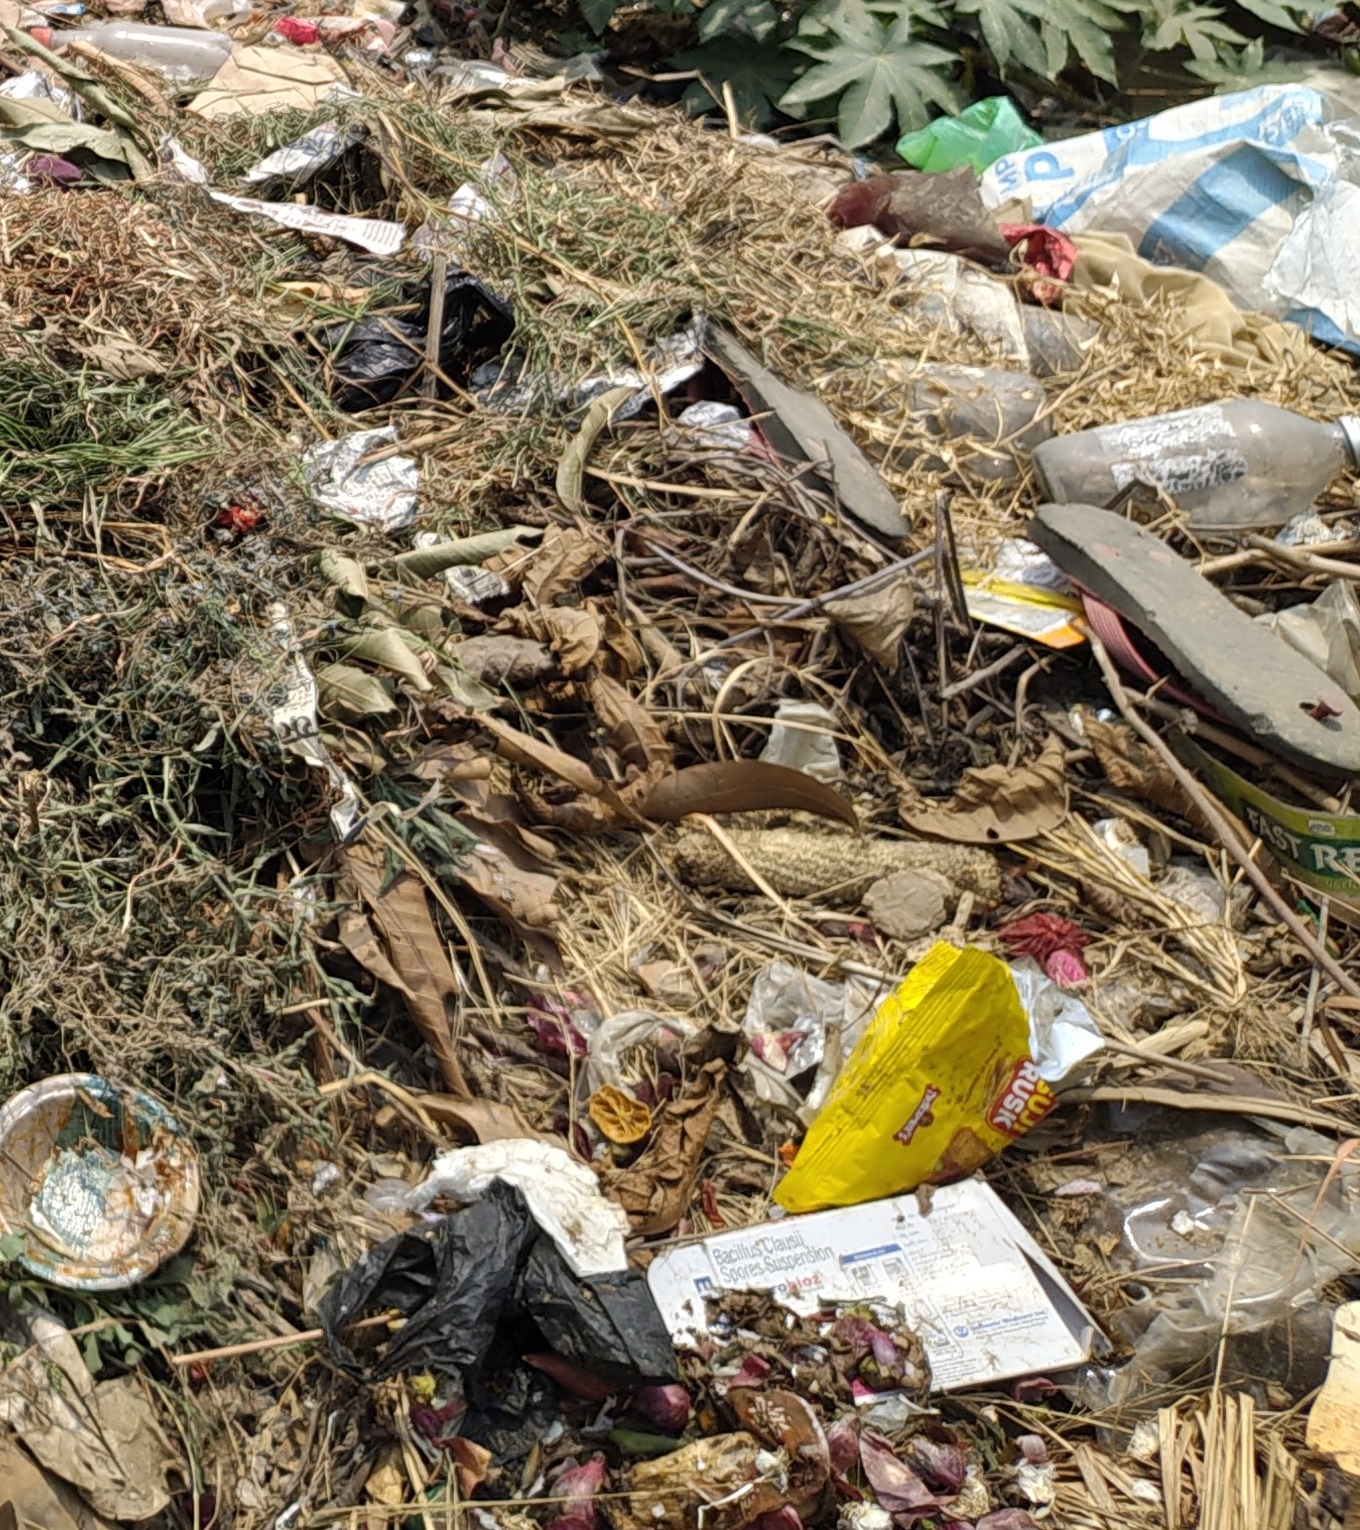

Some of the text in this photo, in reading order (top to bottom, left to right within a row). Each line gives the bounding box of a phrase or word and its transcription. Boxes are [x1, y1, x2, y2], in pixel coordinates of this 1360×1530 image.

[1246, 807, 1301, 859] FAST
[993, 1061, 1039, 1130] RUSK
[712, 1242, 762, 1266] Bacillus
[719, 1260, 765, 1284] Spores
[764, 1245, 834, 1273] Suspension
